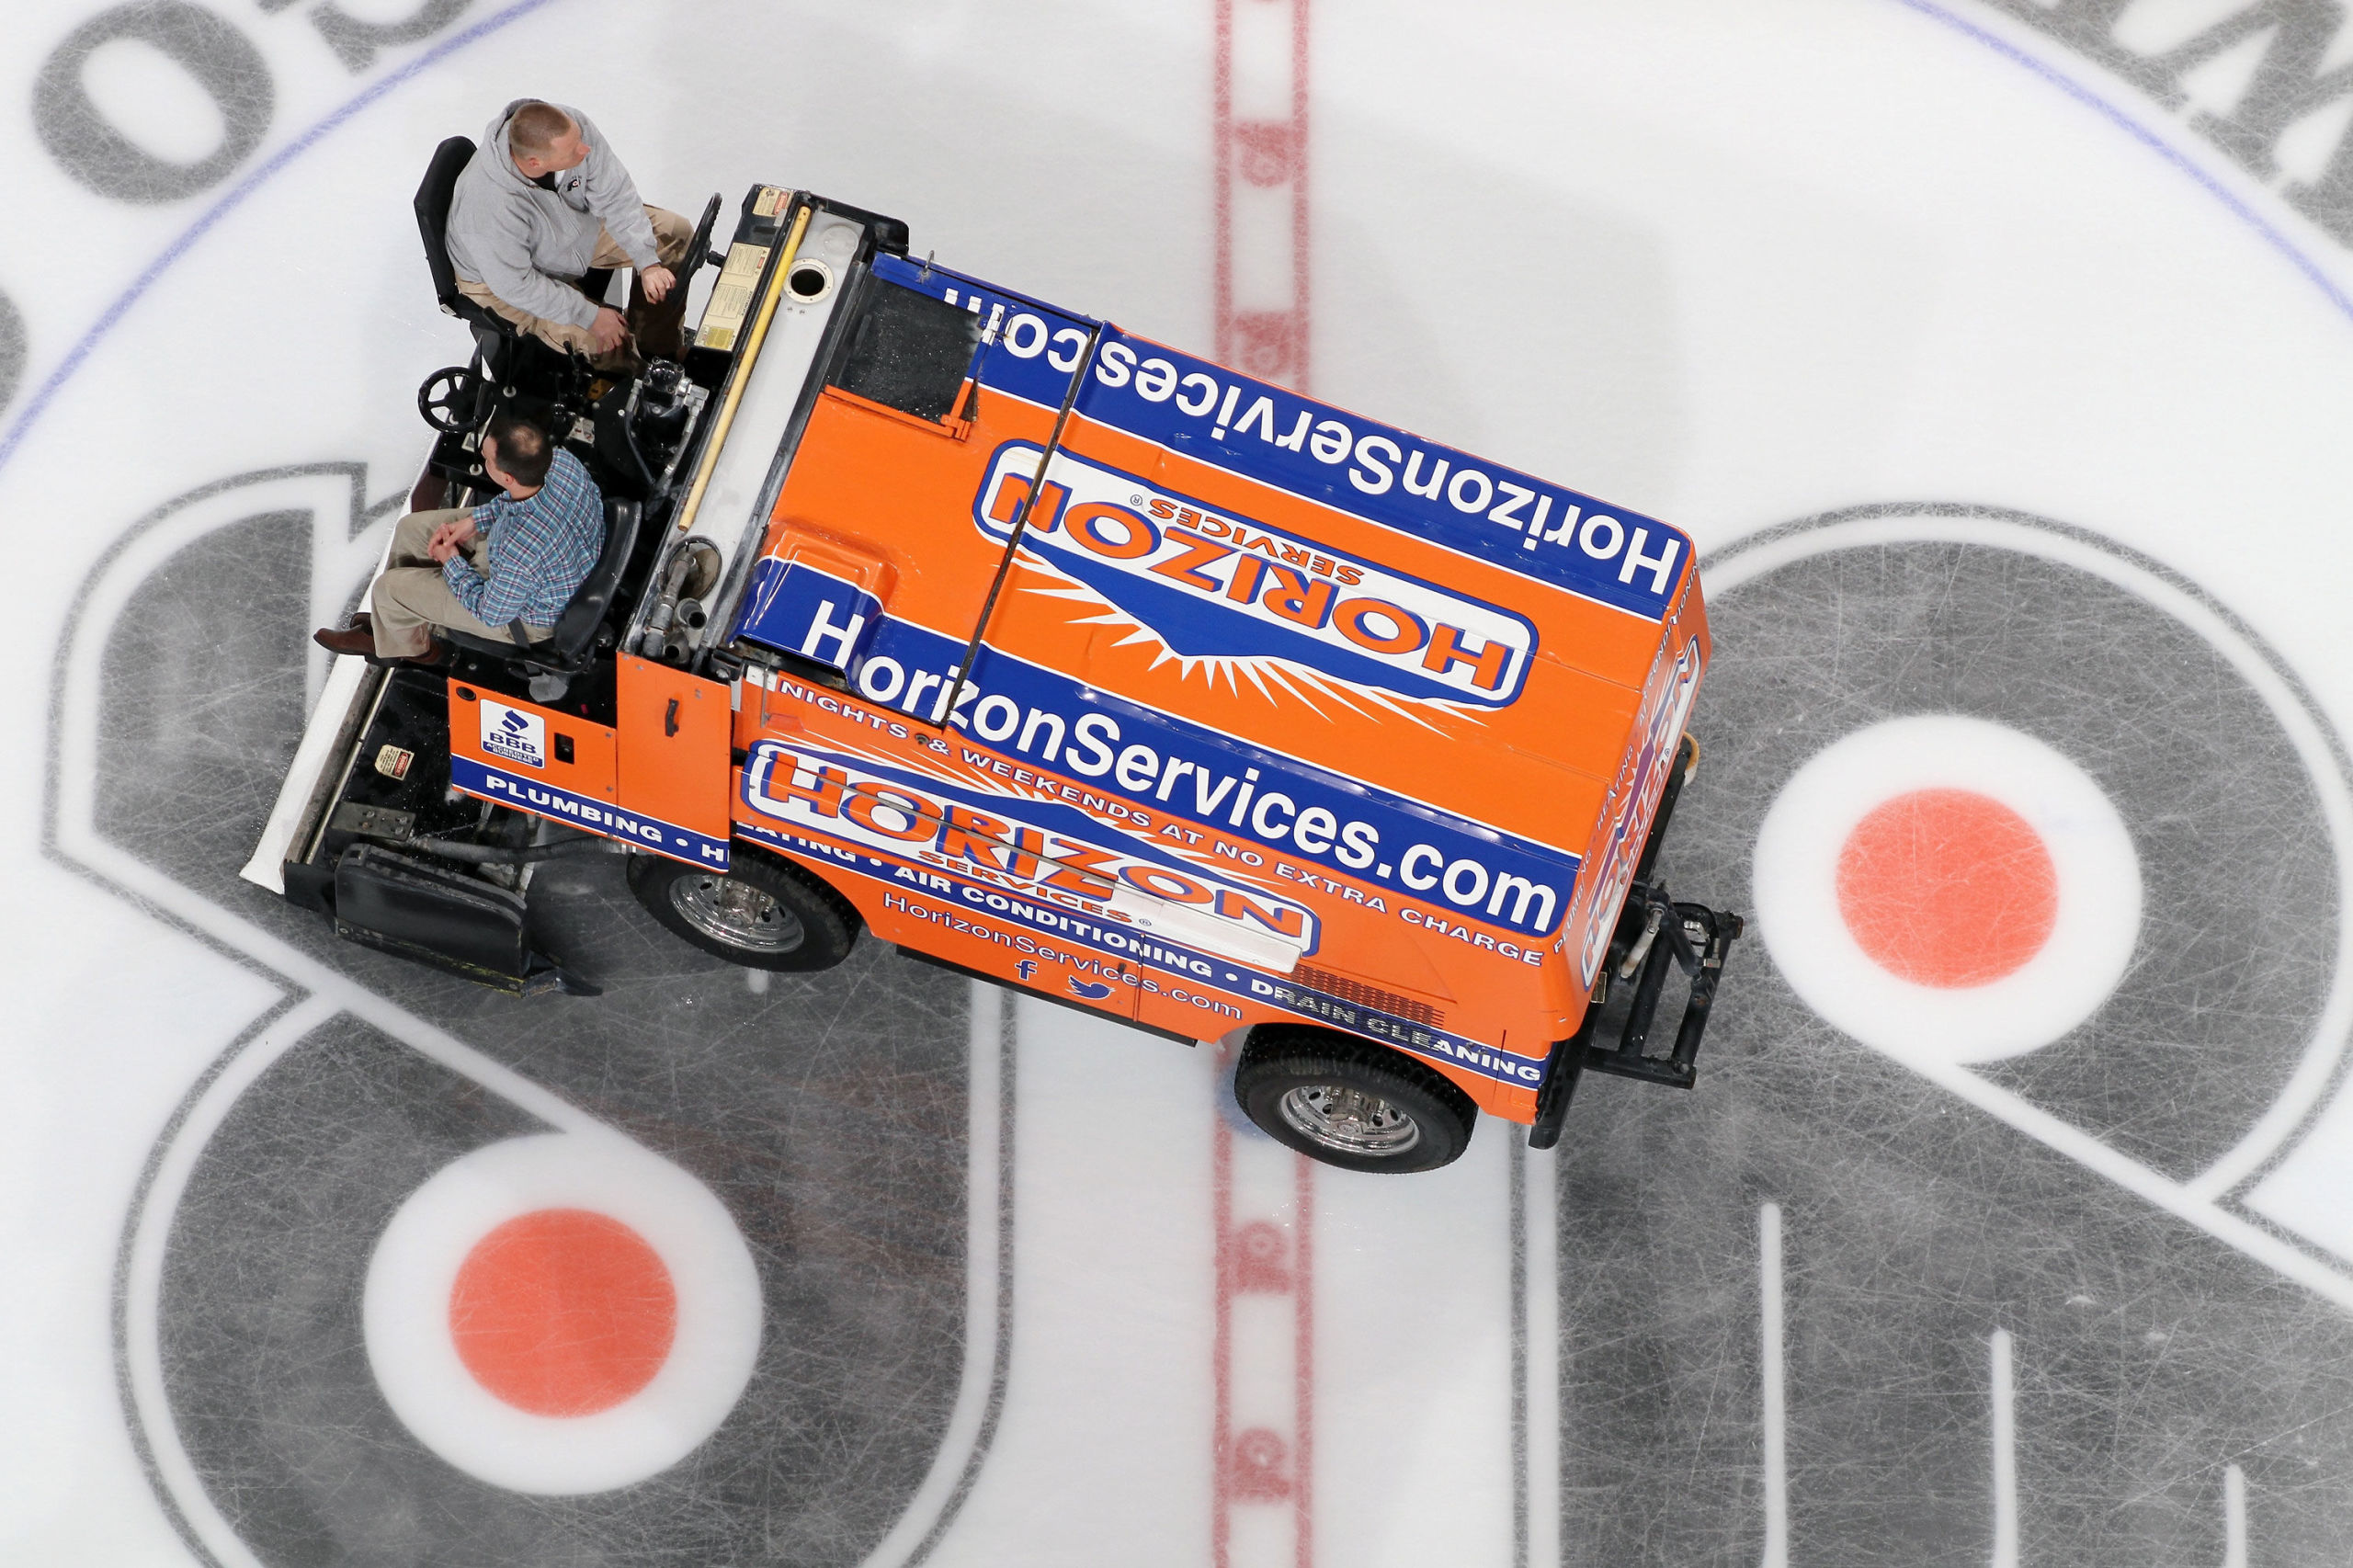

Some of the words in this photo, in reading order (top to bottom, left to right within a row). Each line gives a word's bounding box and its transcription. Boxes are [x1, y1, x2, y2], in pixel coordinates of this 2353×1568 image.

[943, 288, 1680, 596] HorizonServicesco
[990, 473, 1510, 689] HORIZON
[1148, 497, 1364, 586] SERVICES
[486, 743, 539, 762] ACCREDITED
[490, 733, 537, 754] BBB
[493, 748, 533, 764] BUSINESS
[800, 600, 1557, 933] HorizonServices.com
[1597, 744, 1634, 830] HEATING
[761, 751, 1303, 937] HORIZON
[779, 680, 908, 739] NIGHTS
[928, 739, 951, 756] &
[962, 748, 1152, 827] WEEKENDS
[1162, 824, 1204, 845] AT
[1213, 841, 1264, 867] NO
[1275, 862, 1388, 913] EXTRA
[1400, 907, 1545, 966] CHARGE
[918, 850, 1132, 923] SERVICES
[486, 774, 663, 843] PLUMBING
[894, 867, 951, 894] AIR
[962, 886, 1212, 977] CONDITIONING
[1251, 978, 1356, 1025] DRAIN
[1367, 1017, 1541, 1082] CLEANING
[883, 892, 1243, 1019] HorizonServices.com
